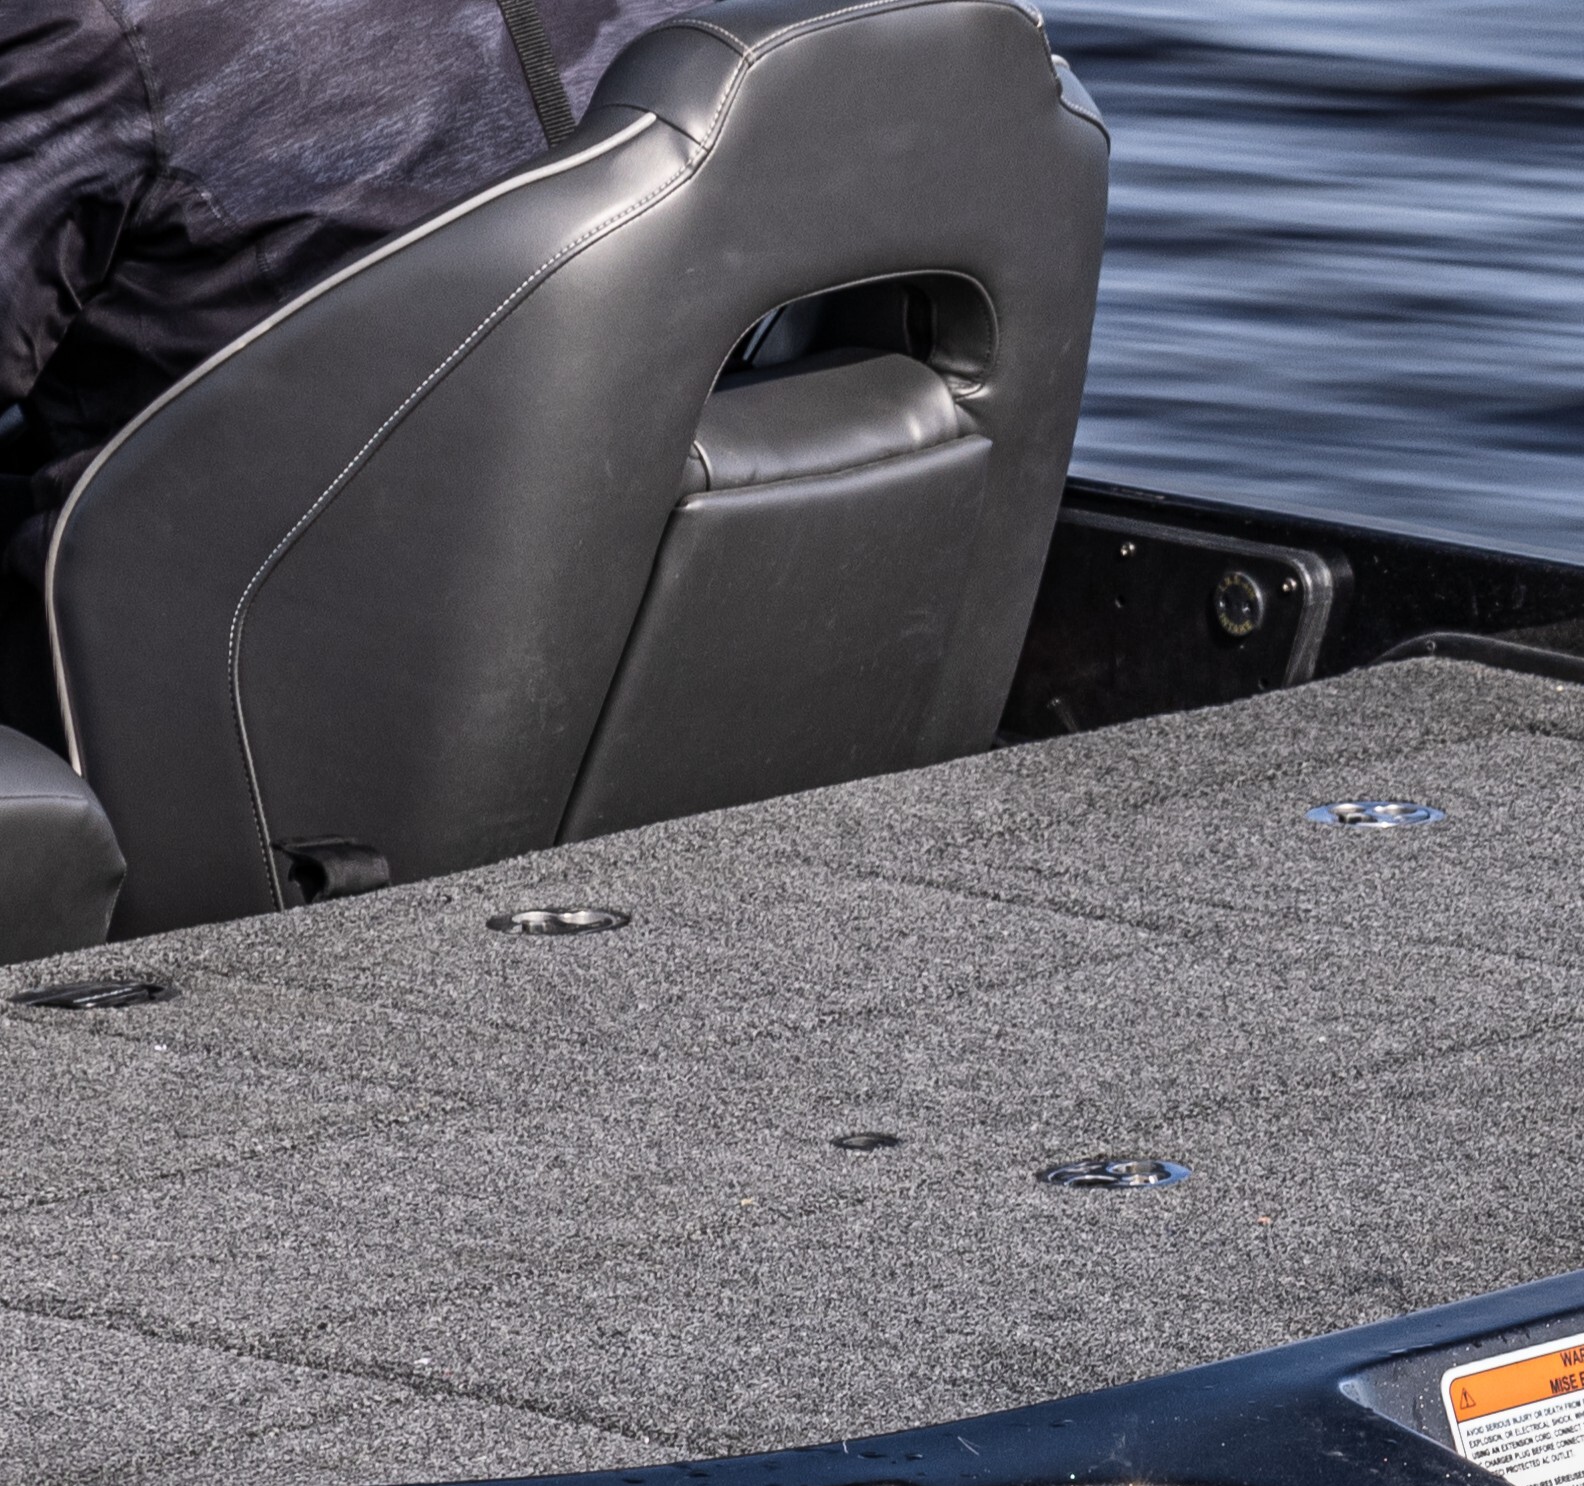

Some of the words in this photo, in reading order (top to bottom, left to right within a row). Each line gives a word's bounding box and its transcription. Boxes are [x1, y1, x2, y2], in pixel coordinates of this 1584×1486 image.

[1549, 1374, 1578, 1395] MISE
[1467, 1426, 1484, 1437] AVOID
[1485, 1419, 1511, 1432] SERIOUS
[1512, 1414, 1532, 1424] INJURY
[1534, 1410, 1542, 1419] OR
[1544, 1405, 1563, 1416] DEATH
[1565, 1400, 1581, 1408] FROM
[1472, 1449, 1490, 1459] USING
[1501, 1438, 1533, 1452] EXTENSION
[1554, 1424, 1580, 1437] CONNECT
[1505, 1430, 1513, 1439] OR
[1515, 1422, 1550, 1436] ELECTRICAL
[1485, 1454, 1513, 1468] CHARGER
[1515, 1449, 1530, 1459] PLUG
[1531, 1443, 1554, 1455] BEFORE
[1506, 1459, 1540, 1474] PROTECTED
[1543, 1456, 1549, 1464] AC
